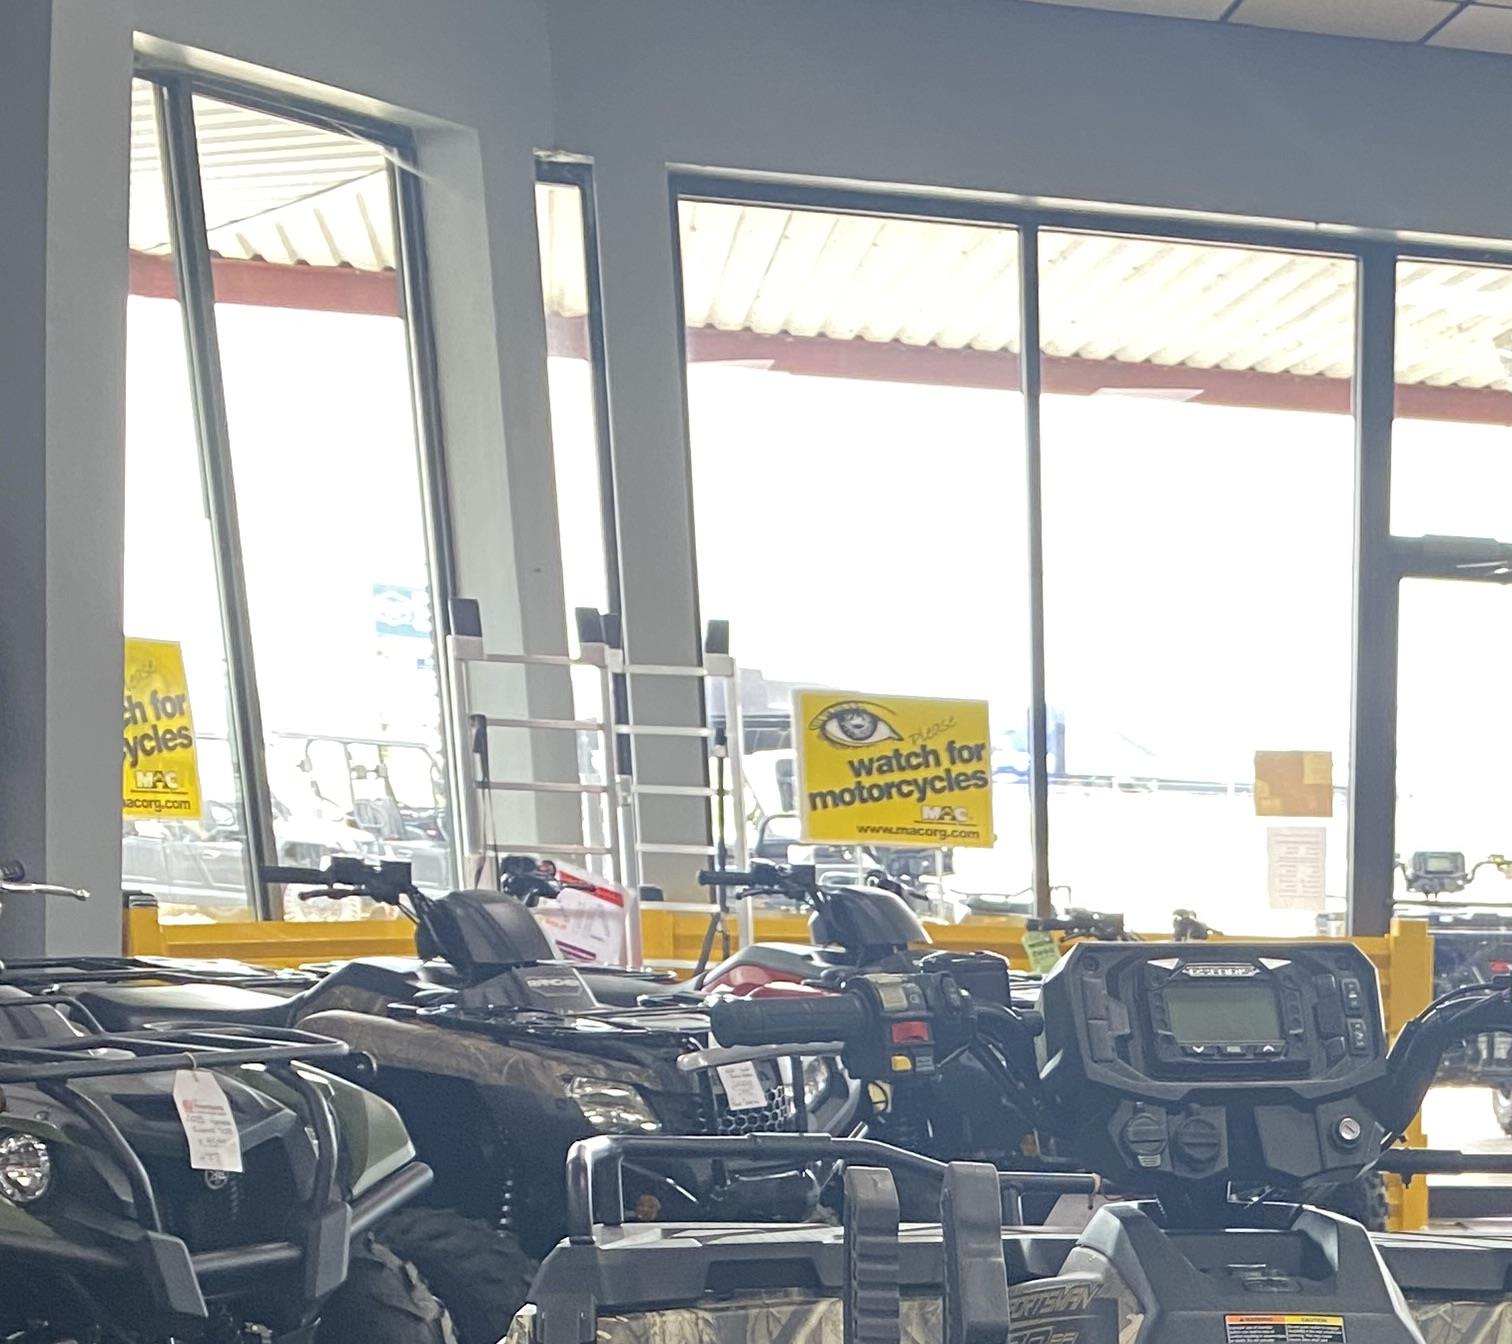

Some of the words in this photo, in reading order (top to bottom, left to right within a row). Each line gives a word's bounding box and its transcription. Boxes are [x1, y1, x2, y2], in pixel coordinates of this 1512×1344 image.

[149, 689, 187, 721] for
[848, 744, 942, 778] watch
[946, 740, 986, 766] for
[808, 768, 989, 811] motorcycles
[856, 824, 980, 840] www.macorg.com
